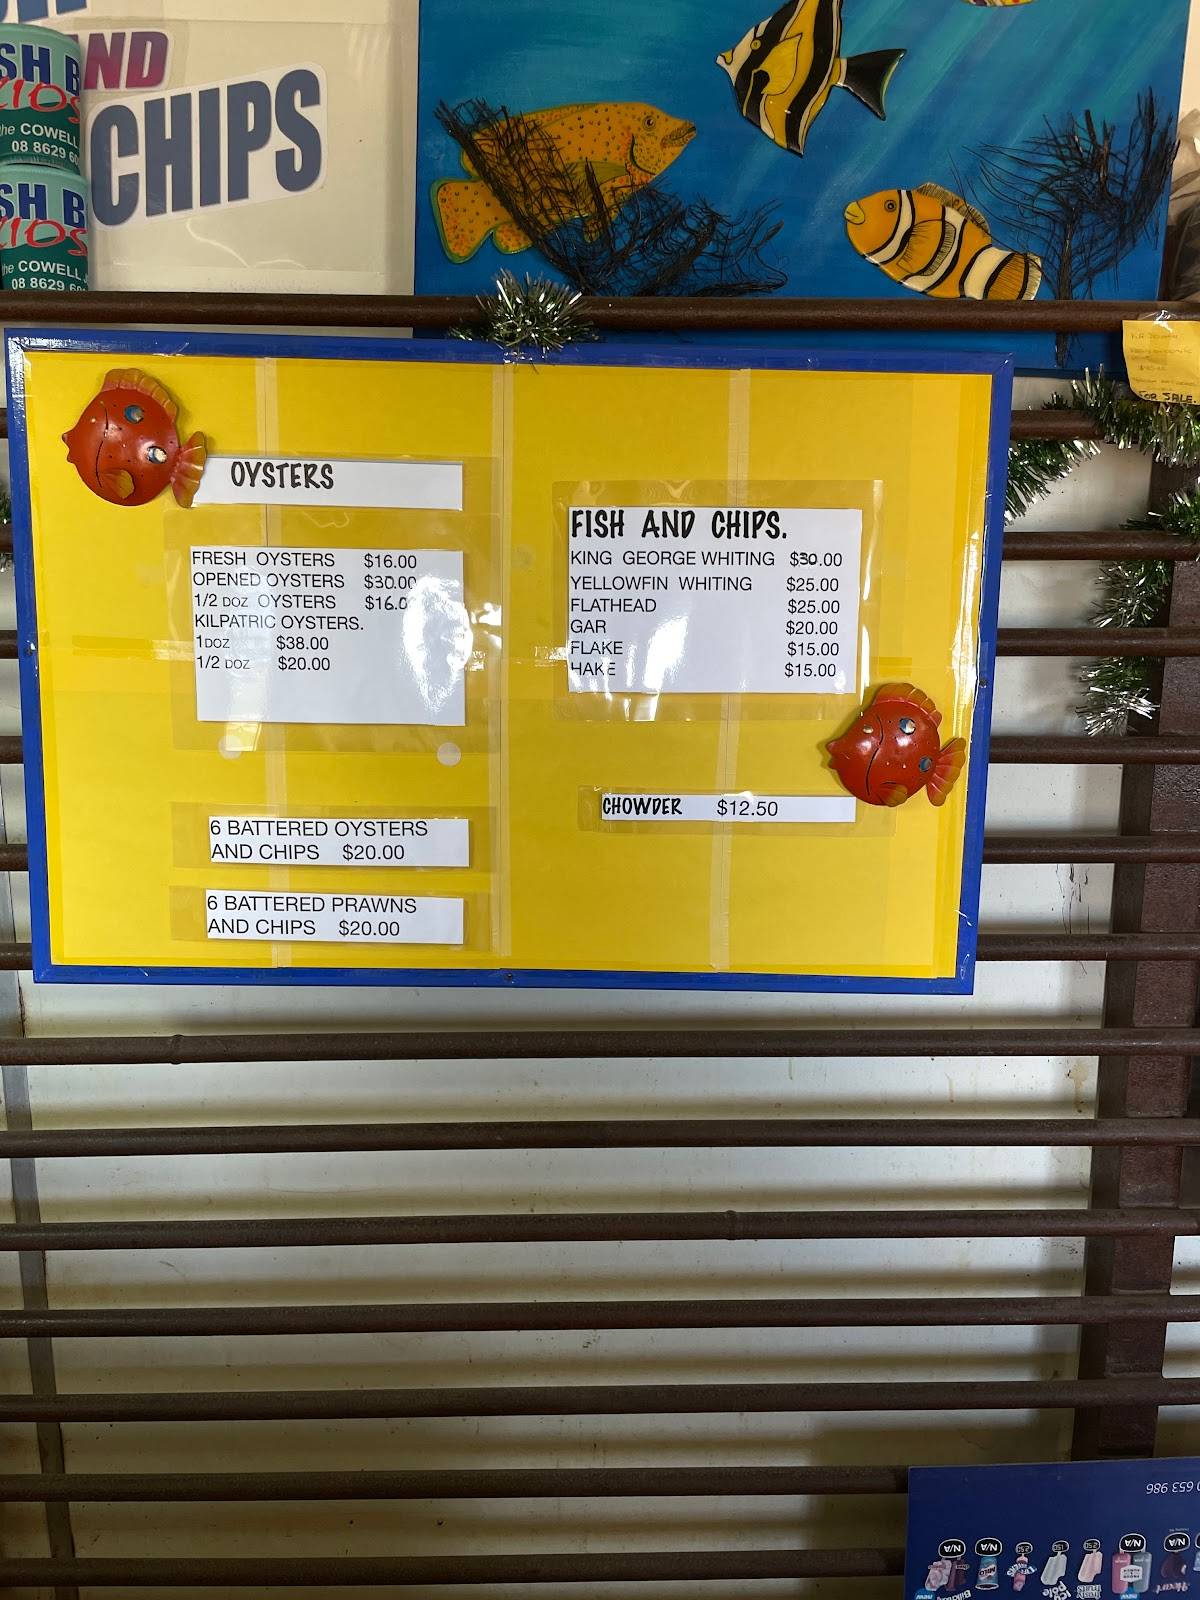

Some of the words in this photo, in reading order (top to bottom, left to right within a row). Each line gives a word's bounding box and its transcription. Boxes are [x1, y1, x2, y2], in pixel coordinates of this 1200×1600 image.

[66, 31, 168, 90] ND
[20, 123, 79, 149] COWELL
[11, 140, 29, 152] 08
[33, 141, 66, 159] 8629
[90, 69, 322, 226] CHIPS
[18, 260, 81, 281] COWELL
[11, 278, 26, 290] 08
[30, 278, 65, 291] 8629
[231, 461, 334, 489] OYSTERS
[571, 510, 625, 539] FISH
[641, 510, 696, 539] AND
[712, 510, 787, 540] CHIPS.
[192, 552, 246, 566] FRESH
[256, 553, 335, 567] OYSTERS
[364, 554, 417, 569] $16.00
[571, 551, 612, 566] KING
[622, 551, 696, 565] GEORGE
[701, 551, 775, 566] WHITING
[789, 552, 843, 567] $30.00
[193, 572, 261, 587] OPENED
[266, 574, 345, 588] OYSTERS
[364, 575, 416, 590] $30.00
[571, 576, 668, 591] YELLOWFIN
[679, 576, 753, 591] WHITING
[786, 577, 839, 593] $25.00
[194, 594, 218, 607] 1/2
[222, 597, 249, 607] DOZ
[258, 595, 336, 608] OYSTERS
[571, 598, 657, 612] FLATHEAD
[788, 599, 840, 615] $25.00
[195, 614, 276, 629] KILPATRIC
[281, 616, 364, 630] OYSTERS.
[571, 619, 606, 634] GAR
[786, 621, 838, 636] $20.00
[276, 636, 329, 651] $38.00
[571, 641, 623, 655] FLAKE
[788, 642, 839, 657] $15.00
[198, 656, 220, 669] 1/2
[225, 659, 250, 670] DOZ
[278, 656, 330, 672] $20.00
[571, 662, 616, 677] HAKE
[785, 663, 836, 678] $15.00
[602, 796, 682, 815] CHOWDER
[717, 800, 779, 817] $12.50
[210, 820, 221, 836] 6
[228, 820, 328, 836] BATTERED
[334, 821, 428, 837] OYSTERS
[211, 844, 252, 859] AND
[259, 844, 320, 860] CHIPS
[342, 843, 405, 861] $20.00
[207, 896, 217, 911] 6
[225, 896, 325, 912] BATTERED
[332, 898, 417, 913] PRAWNS
[208, 919, 249, 934] AND
[255, 919, 316, 935] CHIPS
[339, 920, 400, 936] $20.00
[1146, 1482, 1169, 1495] 986
[1172, 1481, 1194, 1493] 653
[943, 1544, 961, 1553] N/A
[980, 1543, 998, 1551] N/A
[1124, 1539, 1141, 1547] N/A
[1168, 1538, 1186, 1547] N/A
[979, 1566, 996, 1576] MILO
